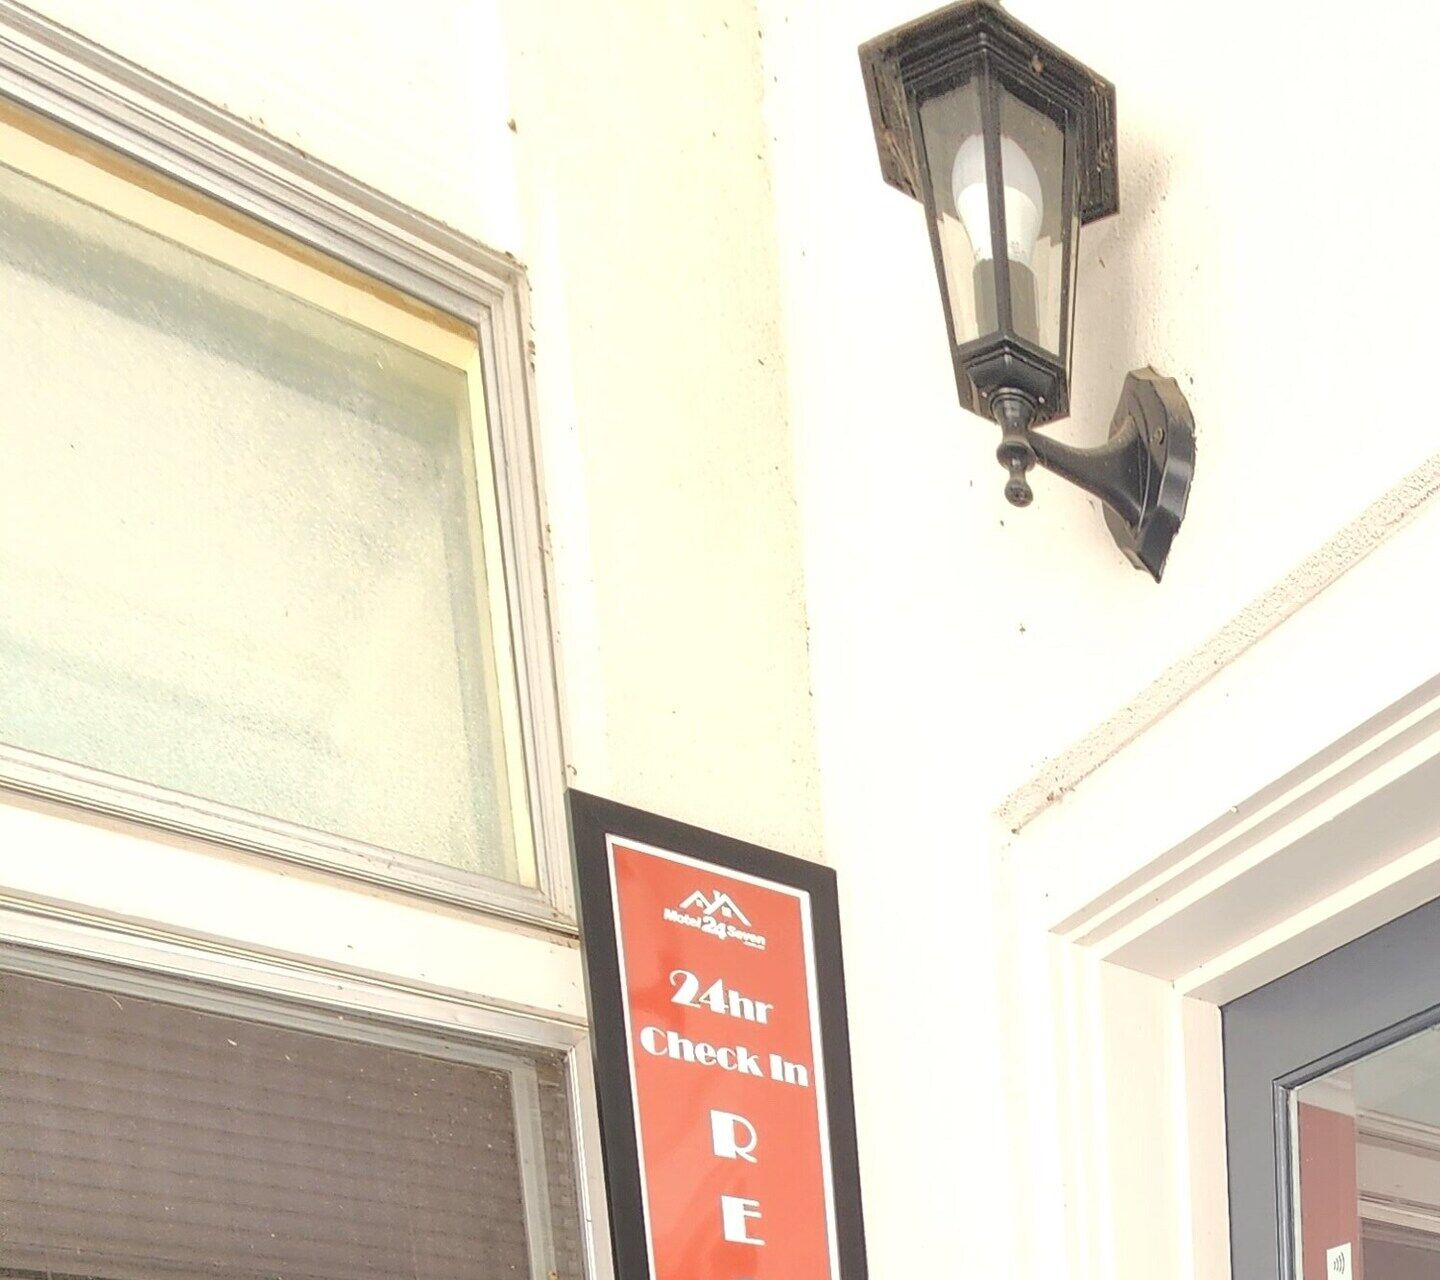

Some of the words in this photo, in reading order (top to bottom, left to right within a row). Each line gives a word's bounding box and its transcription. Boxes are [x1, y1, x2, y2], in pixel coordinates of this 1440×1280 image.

[663, 907, 702, 929] Motel
[701, 915, 727, 941] 24
[726, 925, 766, 947] Seven
[669, 969, 774, 1025] 24hr
[640, 1026, 764, 1077] Check
[769, 1053, 809, 1087] In
